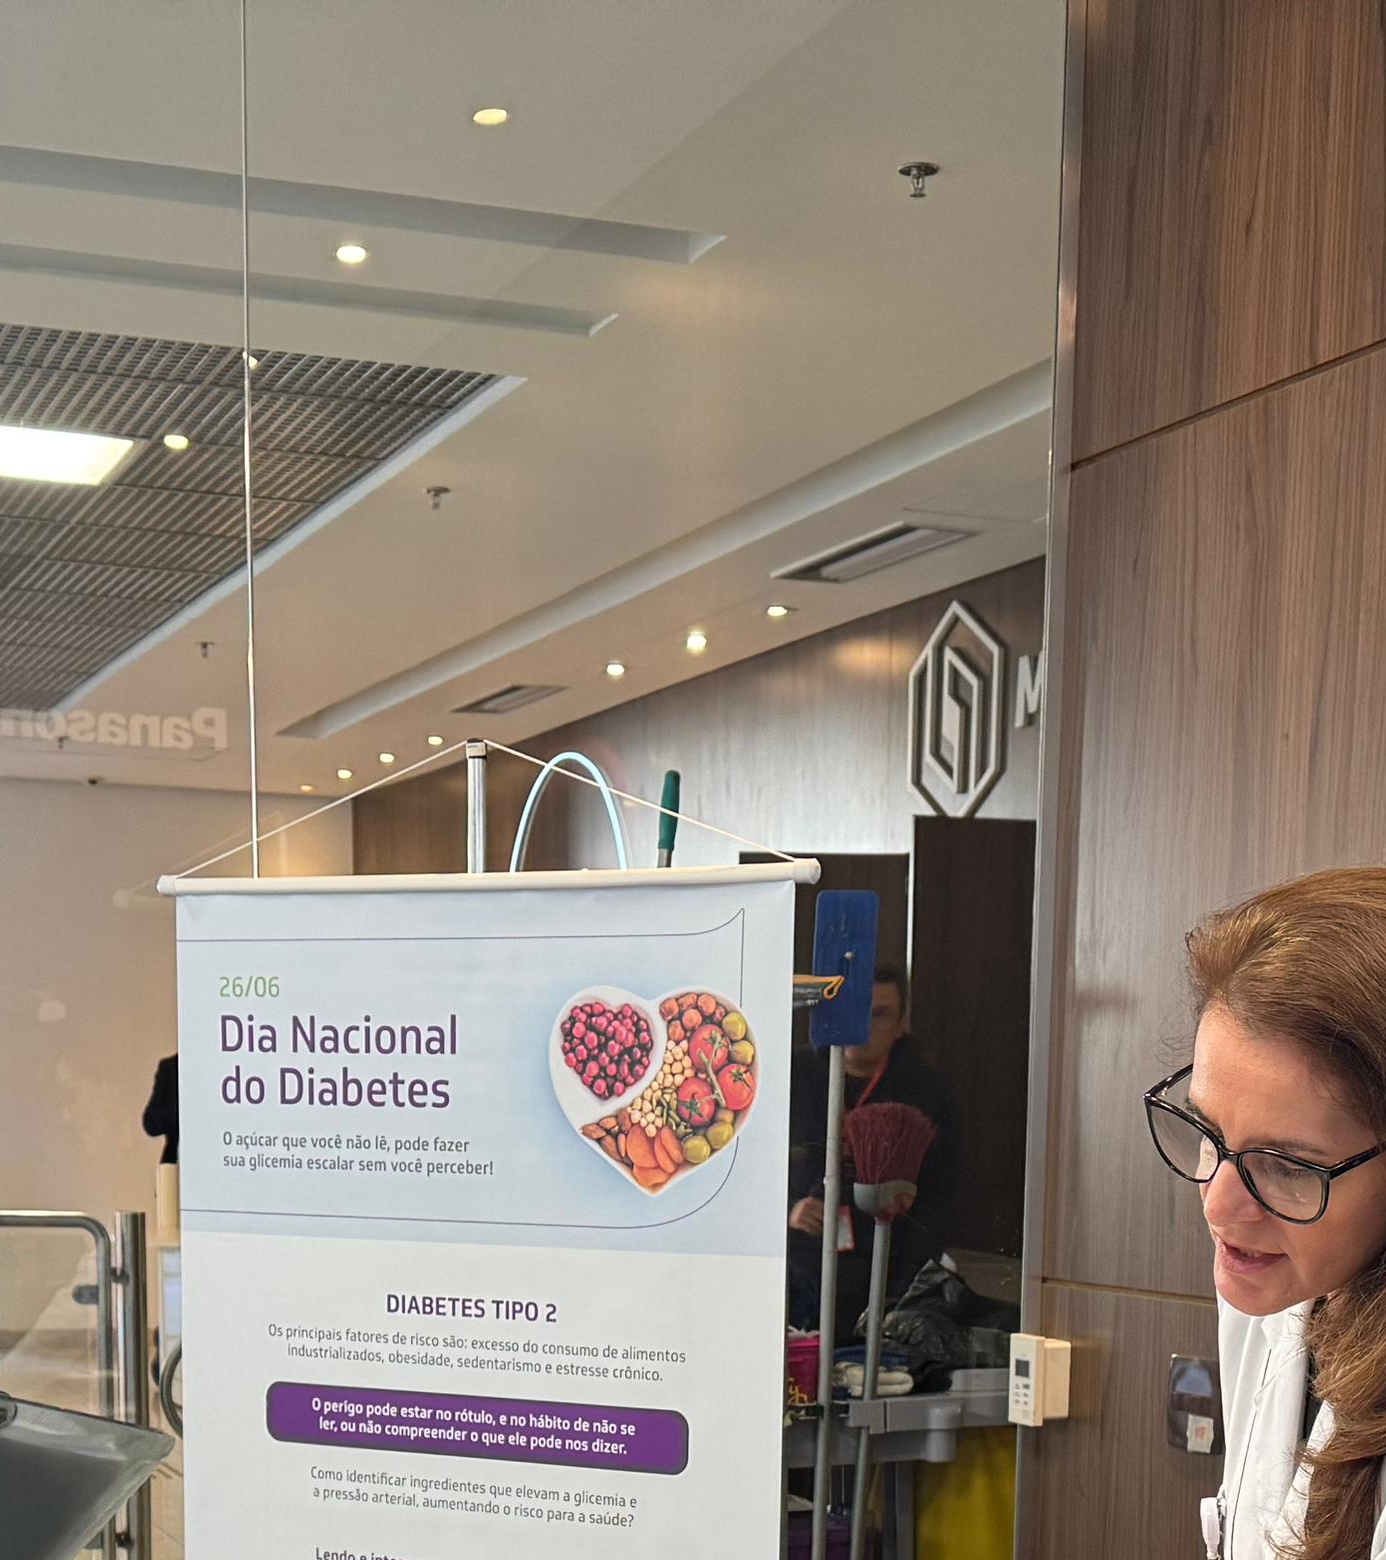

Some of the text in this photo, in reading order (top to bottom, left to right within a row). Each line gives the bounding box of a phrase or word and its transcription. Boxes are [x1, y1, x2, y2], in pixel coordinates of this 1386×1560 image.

[219, 975, 280, 998] 26/06
[221, 1014, 457, 1055] Dia Nacional
[221, 1064, 450, 1109] do Diabetes
[223, 1131, 470, 1155] O açúcar que você não lê, pode fazer
[223, 1153, 493, 1178] sua glicemia escalar sem você perceber!
[386, 1294, 557, 1323] DIABETES TIPO 2
[268, 1323, 686, 1363] Os principais fatores de risco são: excesso do consumo de alimentos
[287, 1343, 663, 1382] industrializados, obesidade, sedentarismo e estresse crônico.
[312, 1397, 636, 1436] O perigo pode estar no rótulo, e no hábito de não se
[319, 1416, 627, 1455] ler, ou não compreender o que ele pode nos dizer.
